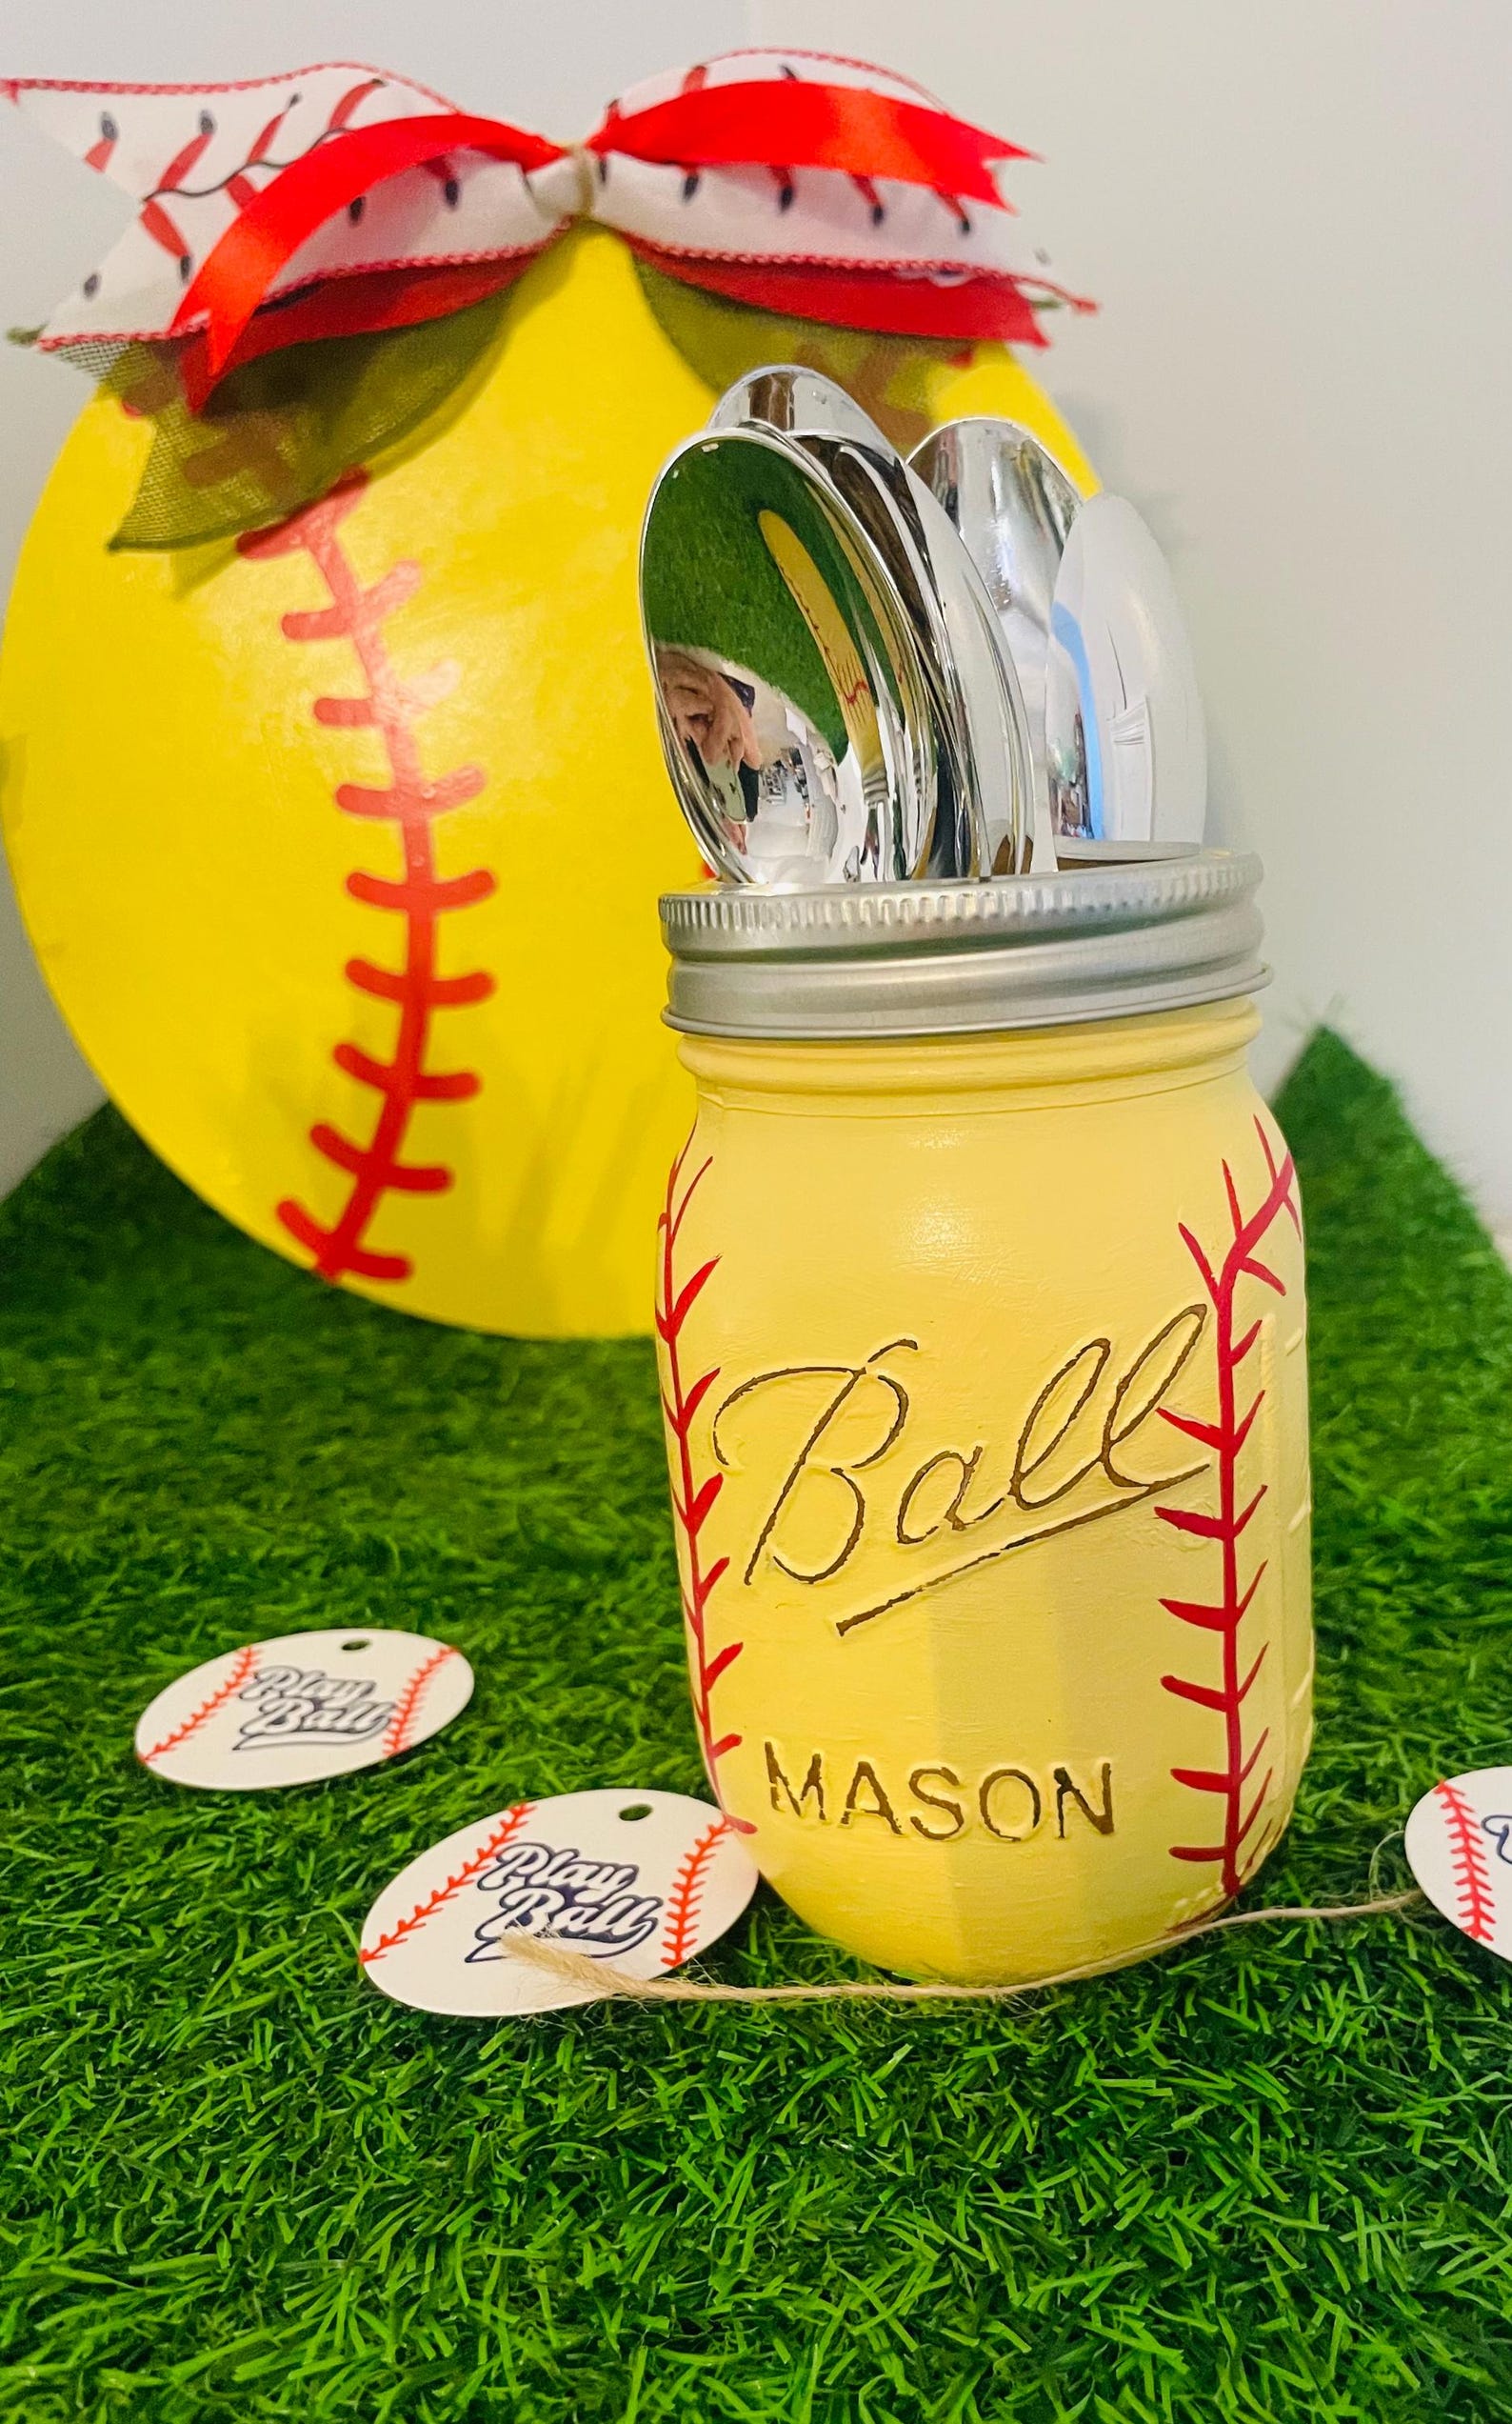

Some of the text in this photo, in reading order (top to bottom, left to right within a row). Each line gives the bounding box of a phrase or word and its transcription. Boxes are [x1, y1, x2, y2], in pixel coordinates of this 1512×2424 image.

[713, 1304, 1207, 1586] Ball
[238, 1665, 377, 1707] Play
[239, 1696, 396, 1735] Ball
[765, 1741, 1115, 1841] MASON
[477, 1842, 639, 1905] Play
[474, 1887, 664, 1944] Ball
